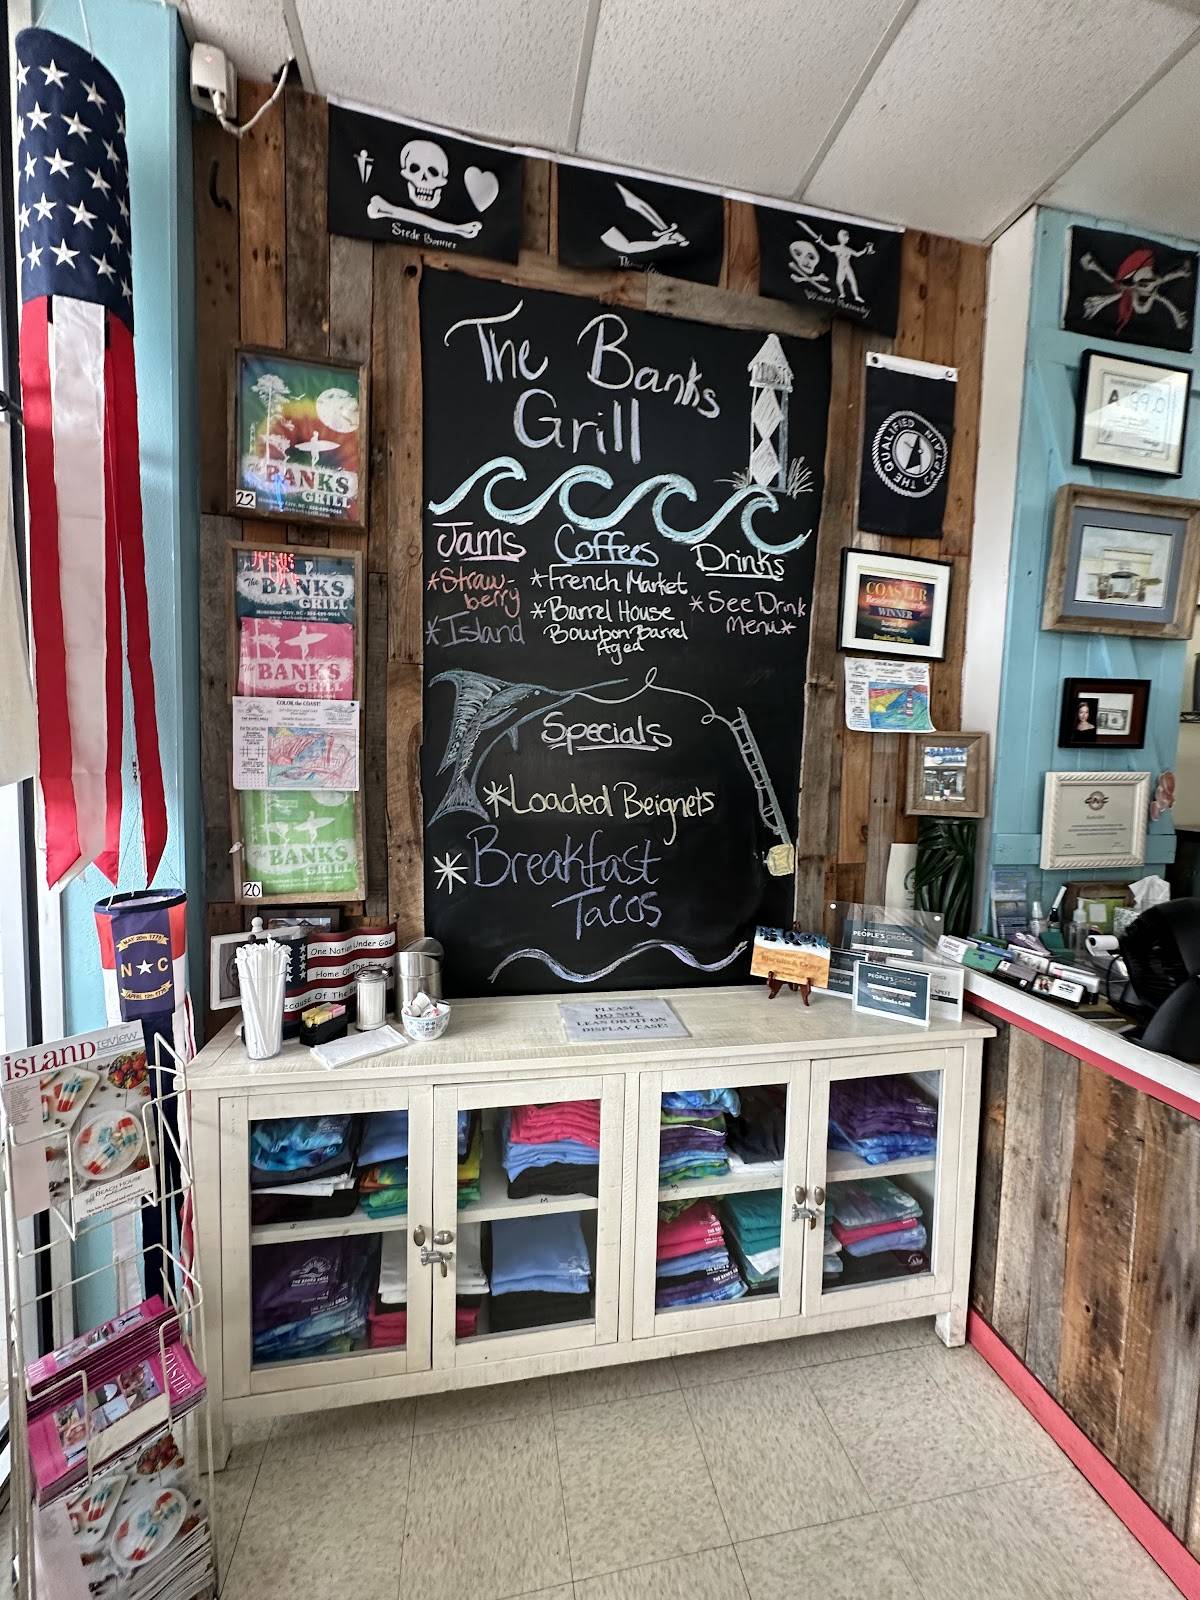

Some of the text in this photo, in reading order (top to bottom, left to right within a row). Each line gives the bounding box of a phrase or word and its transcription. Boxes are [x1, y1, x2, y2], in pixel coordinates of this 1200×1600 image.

[444, 299, 720, 419] The Banks
[513, 389, 642, 464] Grill
[880, 418, 943, 490] THE QUALIFIED CAPTAIN
[266, 464, 349, 495] BANKS
[237, 491, 255, 507] 22
[302, 492, 351, 509] GRILL
[432, 522, 527, 557] Jams
[554, 523, 659, 565] Coffees
[690, 542, 785, 577] Drinks
[262, 578, 345, 598] BANKS
[549, 564, 688, 595] French Market
[299, 597, 348, 610] GRILL
[464, 588, 520, 618] berry
[545, 595, 675, 622] Barrel House
[708, 591, 807, 617] See Drink
[878, 607, 913, 620] WINNER
[438, 611, 525, 647] Island
[544, 621, 689, 645] Bourbon Barrel
[597, 639, 645, 665] Aged
[258, 663, 341, 680] BANKS
[295, 681, 344, 693] GRILL
[541, 711, 673, 756] Specials
[508, 773, 716, 846] Loaded Beignets
[270, 845, 349, 867] BANKS
[466, 824, 663, 889] Breakfast
[305, 863, 352, 876] GRILL
[243, 883, 261, 898] 20
[552, 886, 663, 941] Tacos
[853, 929, 885, 940] PEOPLE'S
[311, 948, 327, 956] One
[353, 939, 377, 949] Under
[121, 957, 169, 978] N C
[316, 970, 340, 979] Home
[867, 971, 894, 982] PEOPLE'S
[314, 992, 328, 1000] Of
[333, 990, 348, 999] The
[96, 1031, 138, 1048] review
